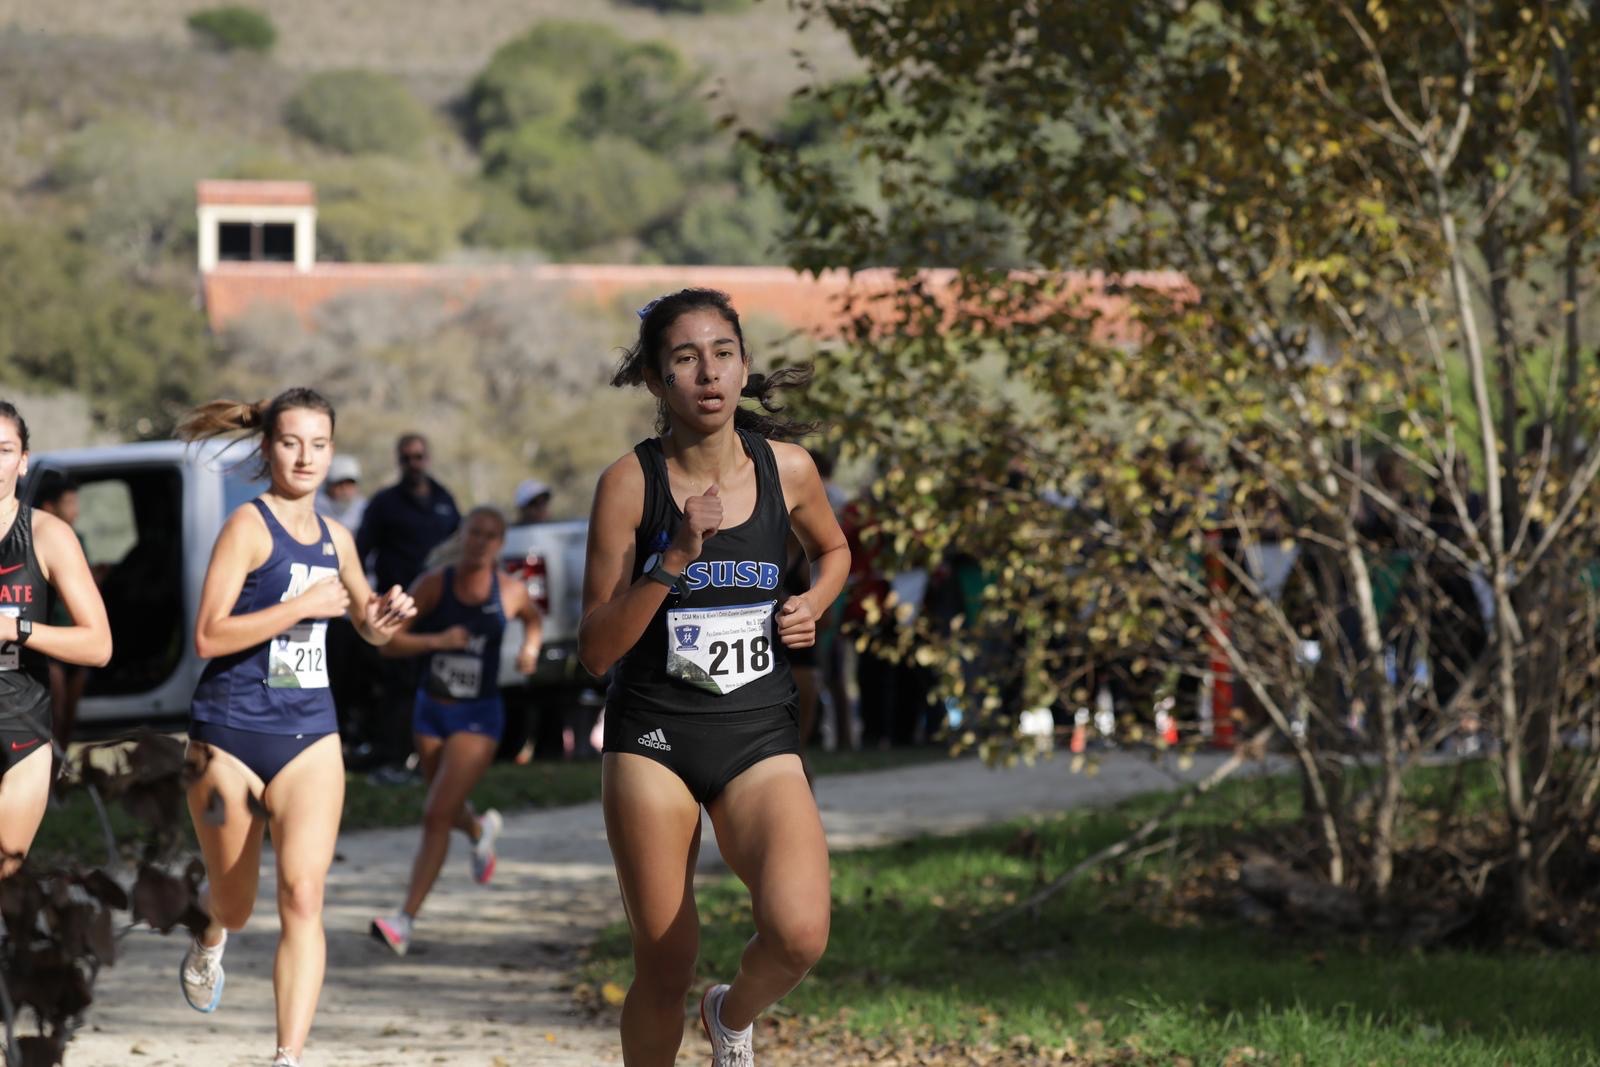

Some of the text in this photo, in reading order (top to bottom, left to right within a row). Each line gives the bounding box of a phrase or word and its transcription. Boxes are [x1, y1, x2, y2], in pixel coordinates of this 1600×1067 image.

[670, 561, 779, 594] SUSB
[295, 647, 323, 673] 212
[709, 636, 770, 675] 218
[637, 737, 672, 752] adidas
